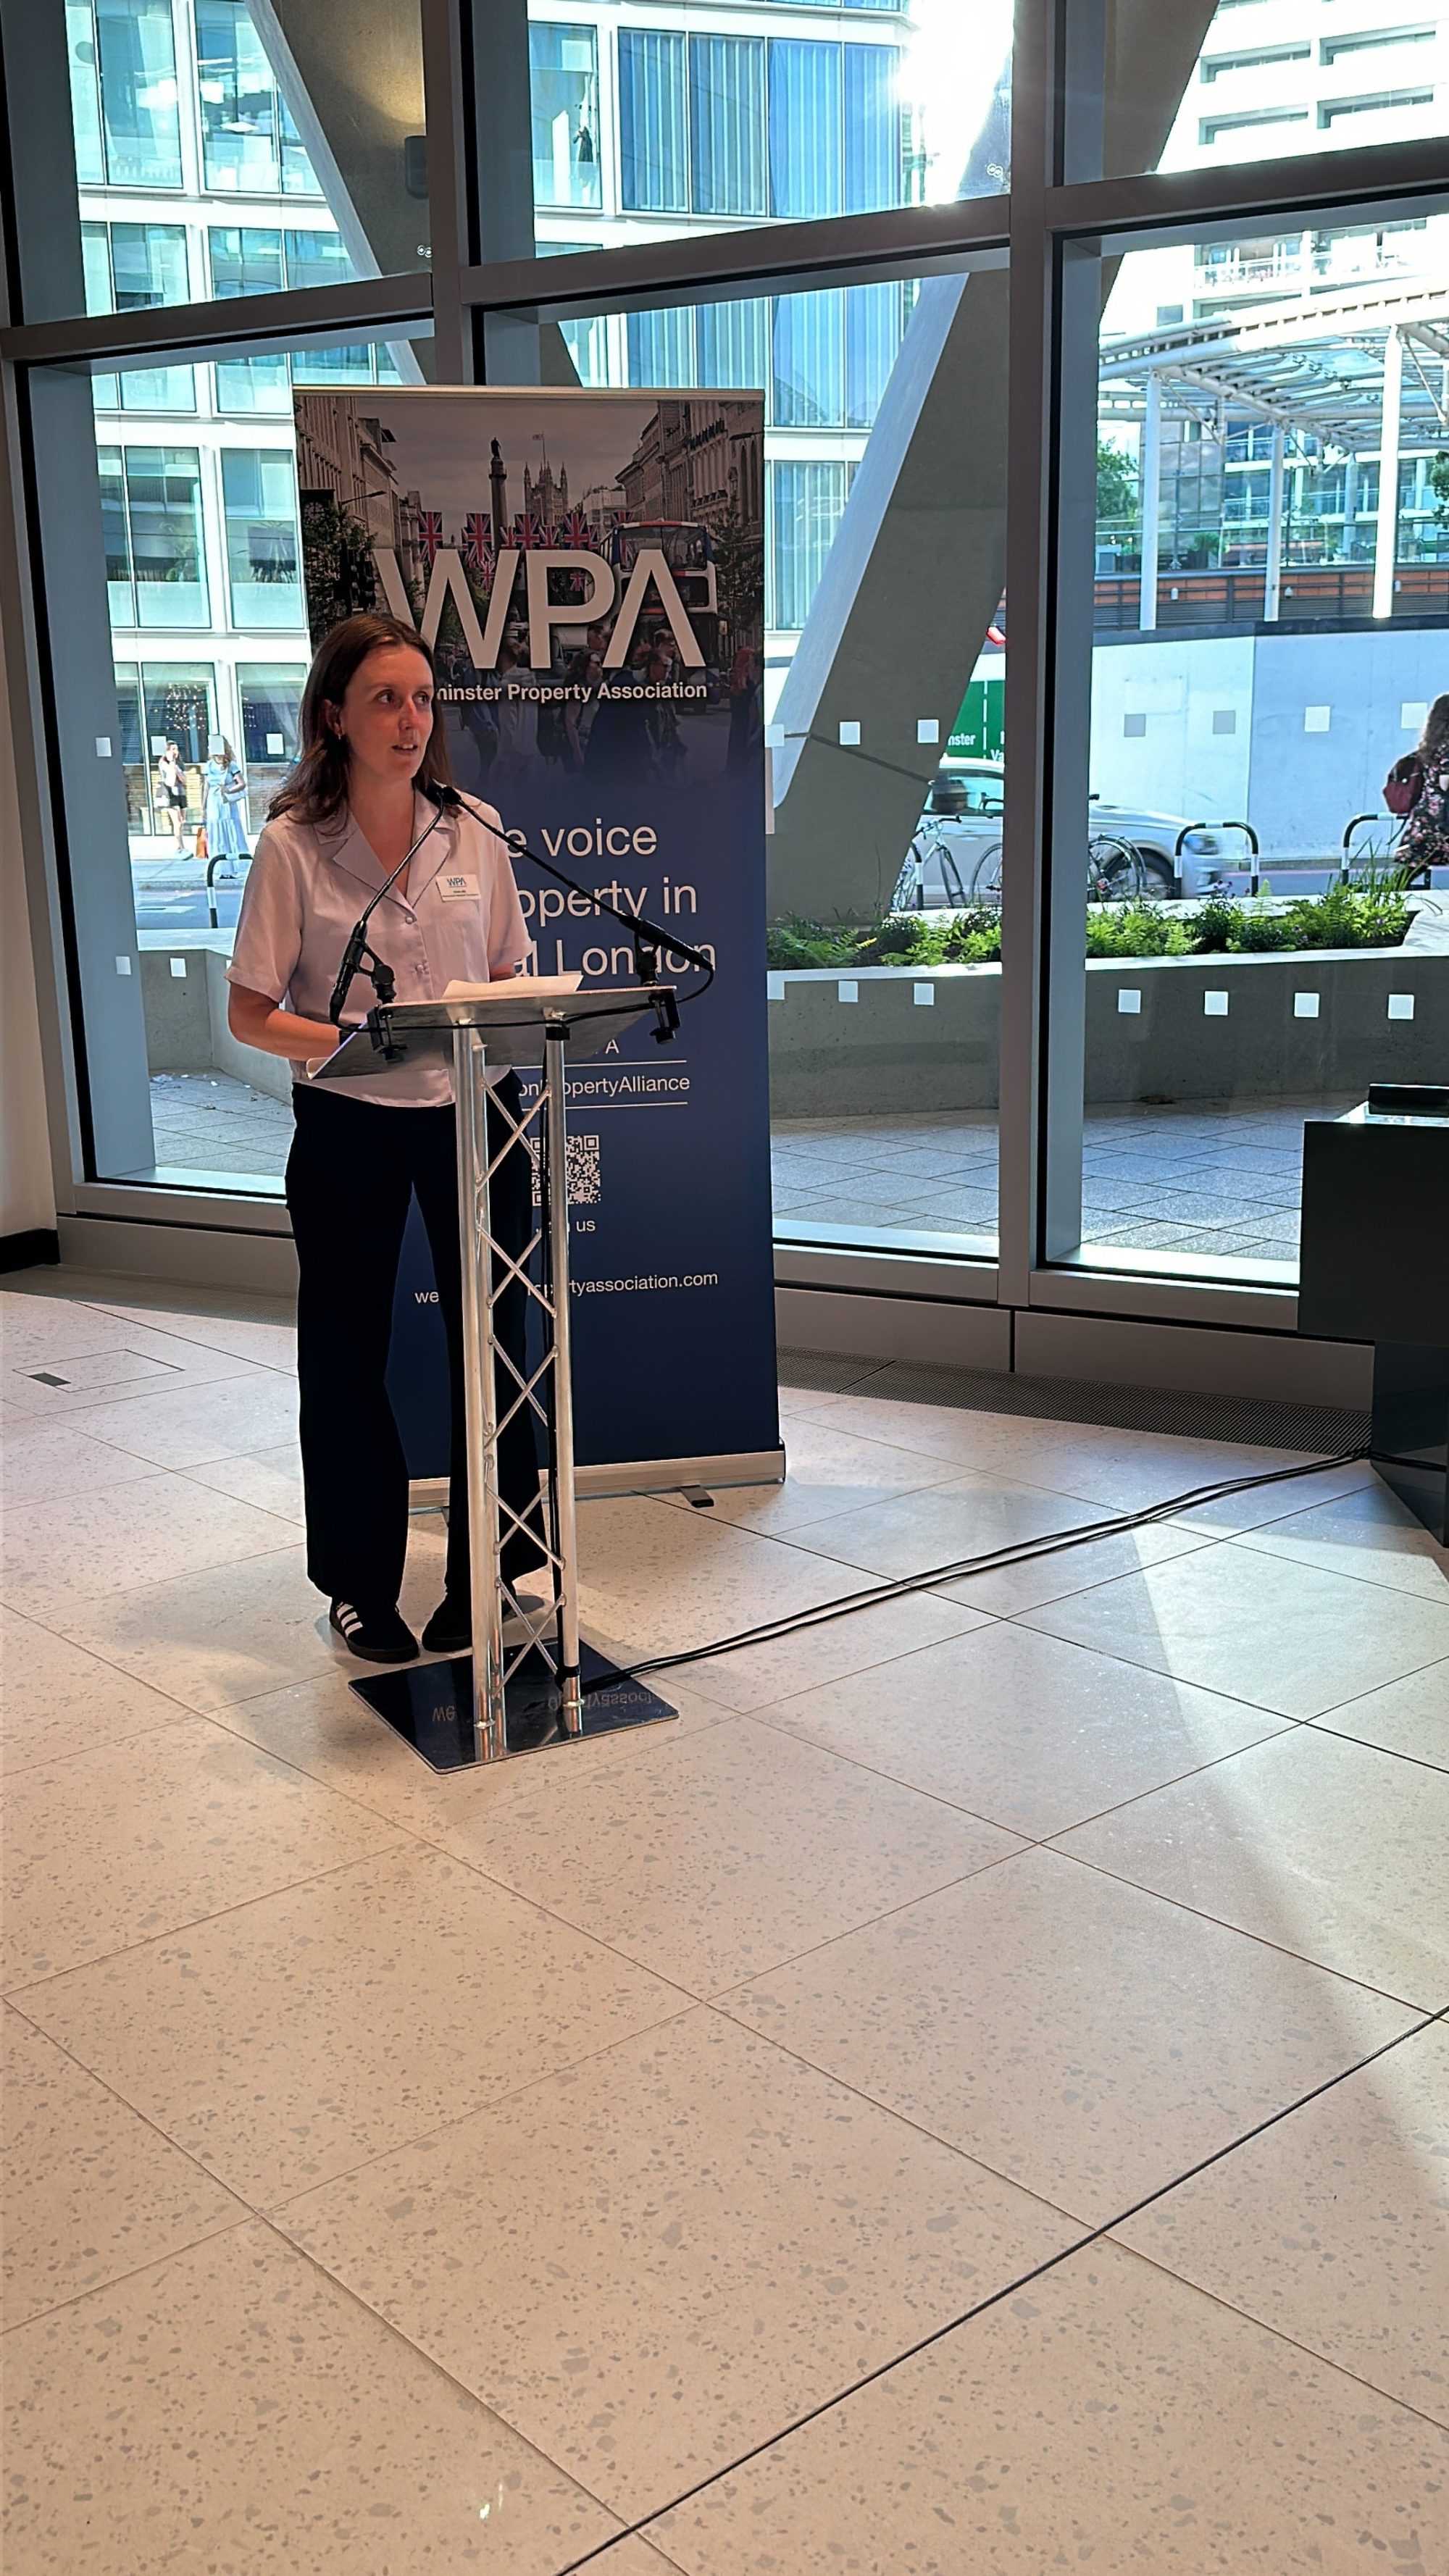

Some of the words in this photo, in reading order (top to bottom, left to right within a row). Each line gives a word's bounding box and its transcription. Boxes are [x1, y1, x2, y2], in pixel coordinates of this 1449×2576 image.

[373, 549, 706, 669] WPA
[508, 683, 592, 704] Property
[597, 682, 707, 700] Association
[540, 818, 658, 857] voice
[662, 877, 697, 914] in
[576, 1219, 596, 1232] us
